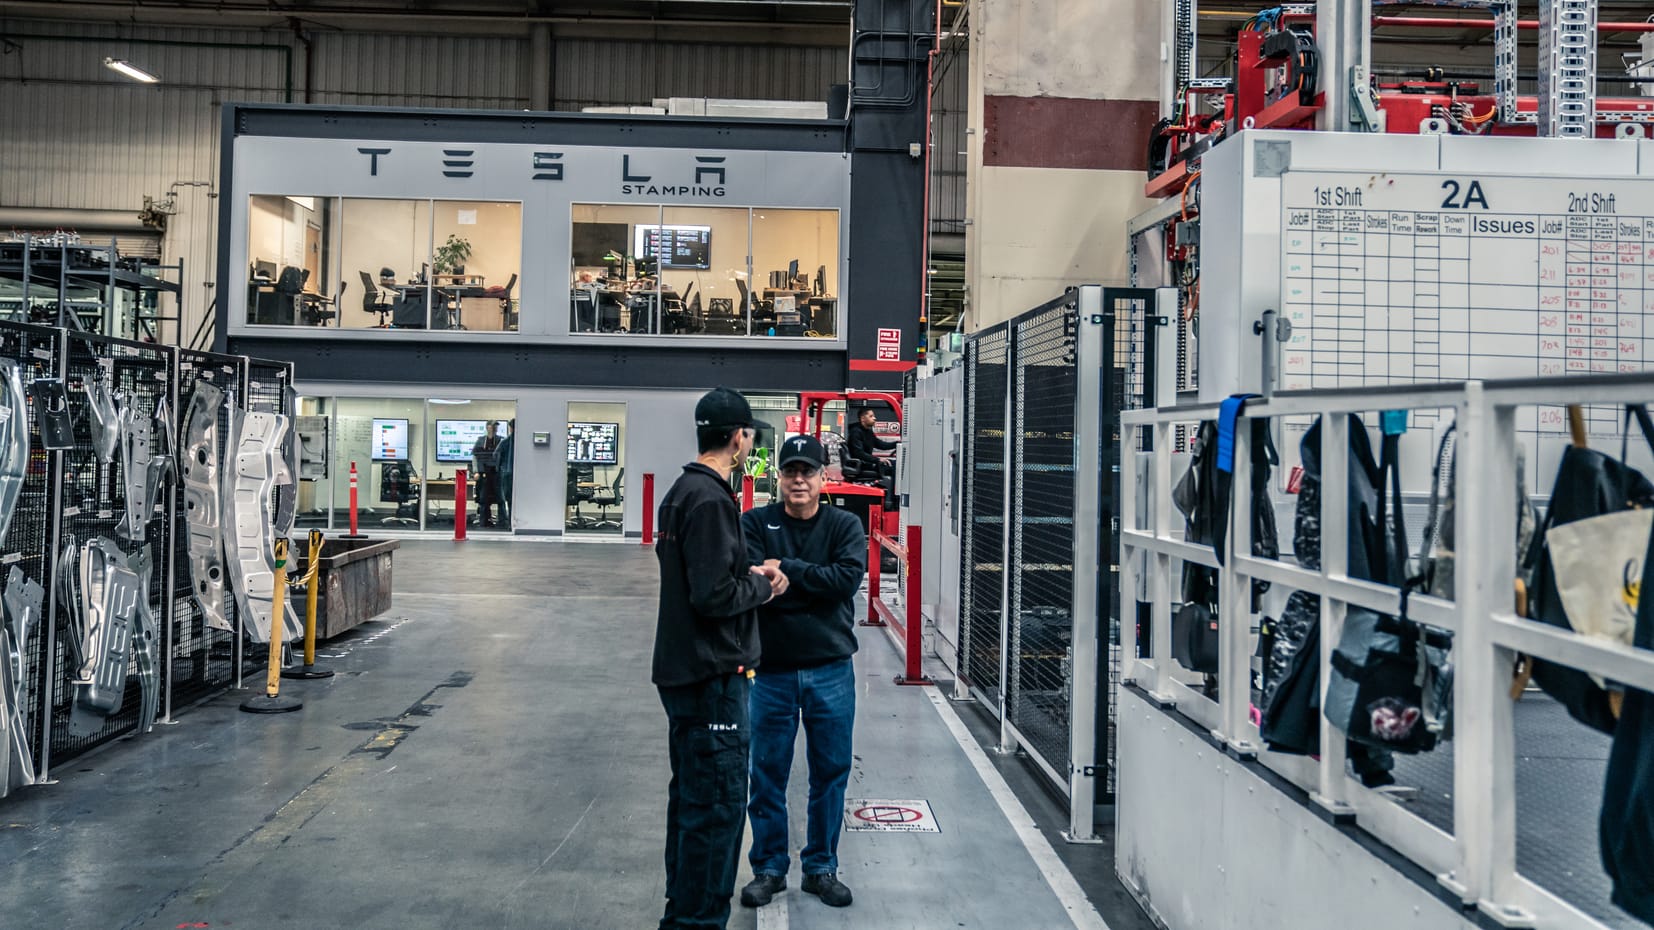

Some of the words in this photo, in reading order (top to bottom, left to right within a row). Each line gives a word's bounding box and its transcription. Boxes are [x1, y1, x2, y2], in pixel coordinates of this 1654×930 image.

[357, 148, 726, 184] TESLA
[622, 184, 726, 197] STAMPING
[1314, 187, 1331, 206] 1st
[1335, 186, 1362, 207] Shift
[1441, 180, 1489, 209] 2A
[1568, 192, 1588, 213] 2nd
[1591, 192, 1616, 214] Shift
[1289, 211, 1309, 225] Job#
[1391, 213, 1409, 222] Run
[1416, 213, 1438, 222] Scrap
[1443, 215, 1465, 224] Down
[1473, 215, 1535, 234] Issues
[1392, 223, 1412, 232] Time
[1444, 225, 1463, 234] Time
[1542, 219, 1563, 234] Job#
